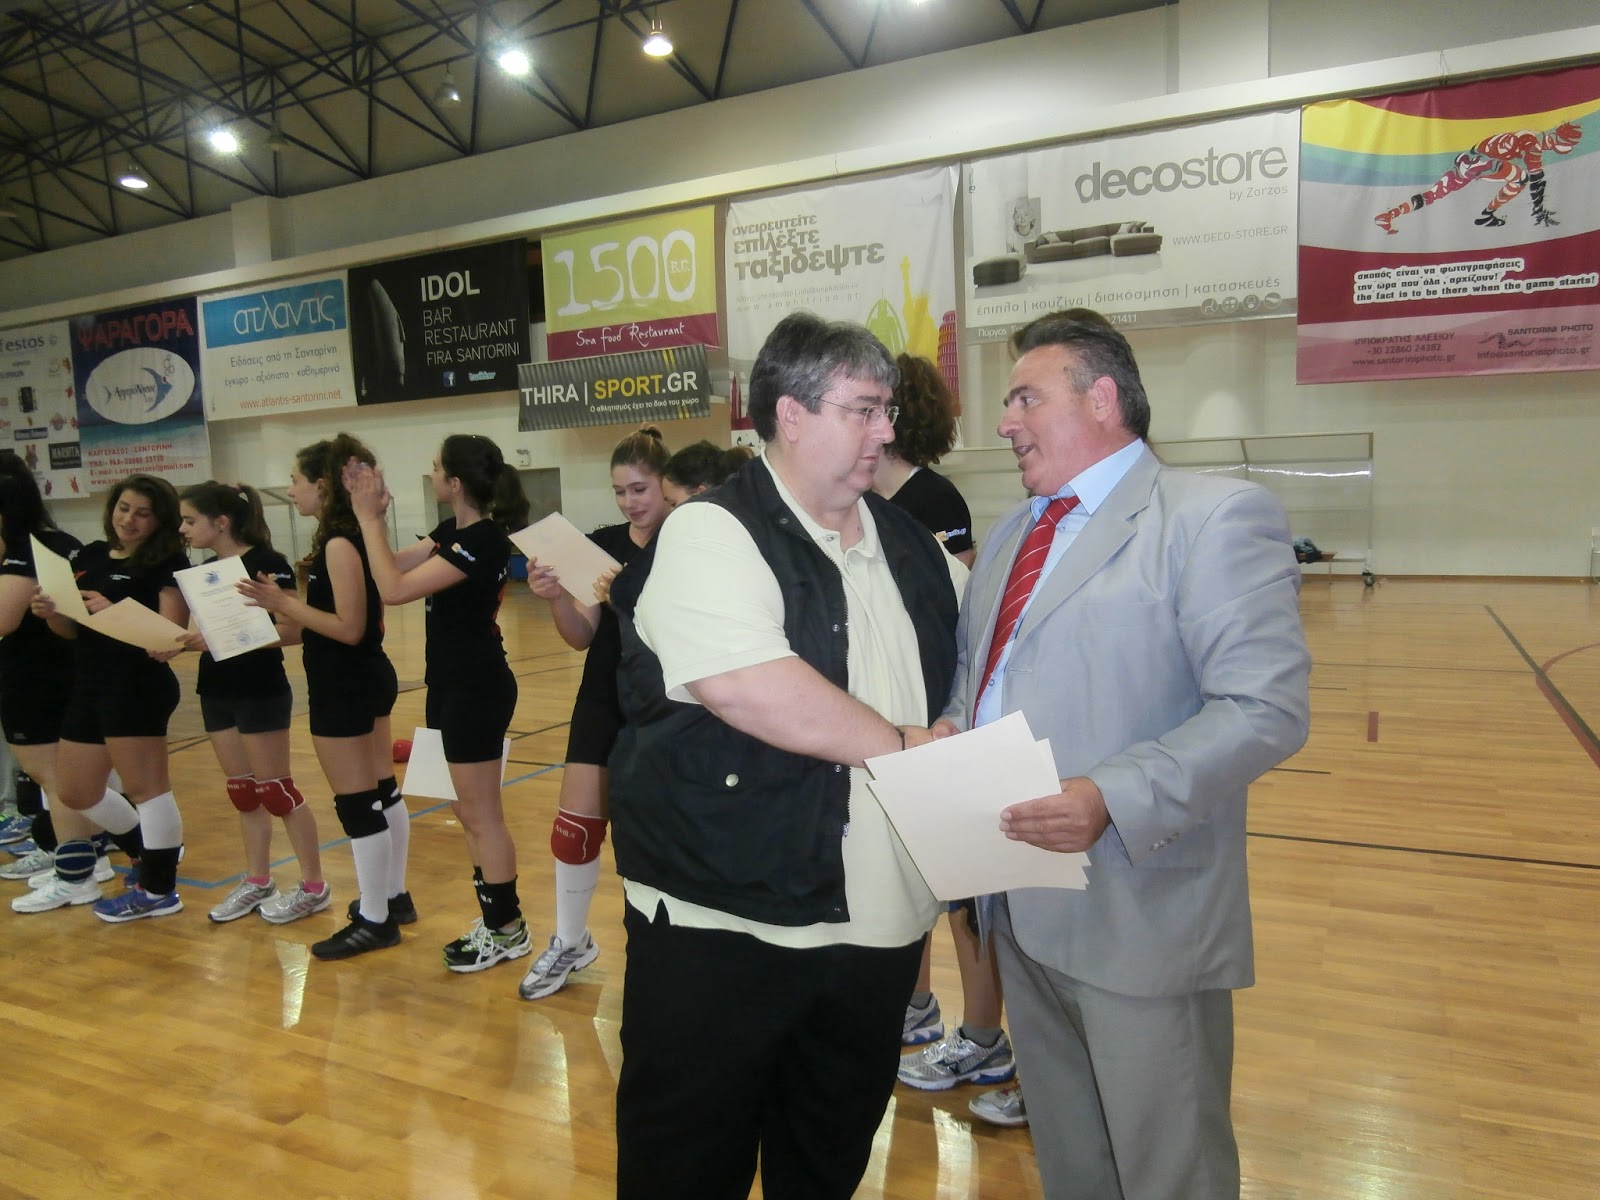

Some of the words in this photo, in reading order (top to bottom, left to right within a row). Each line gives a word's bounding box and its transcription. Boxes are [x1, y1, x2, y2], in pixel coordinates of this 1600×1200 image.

[1074, 146, 1289, 204] decostore
[1229, 188, 1242, 202] by
[1246, 184, 1289, 199] Zorzos
[733, 228, 820, 256] επιλέξτε
[1172, 225, 1289, 247] WWW.DECO-STORE.GR
[553, 228, 697, 317] 1500
[733, 243, 885, 284] ταξιδέψτε
[1357, 270, 1392, 280] σκοπός
[1423, 267, 1436, 275] να
[420, 270, 481, 302] IDOL
[1031, 296, 1084, 311] κουζίνα
[1094, 286, 1180, 304] διακόσμηση
[1193, 276, 1280, 294] κατασκευές
[1356, 293, 1372, 302] the
[1375, 291, 1395, 300] fact
[1398, 290, 1408, 298] is
[1411, 289, 1422, 297] to
[1426, 288, 1438, 296] be
[1441, 285, 1468, 295] there
[1472, 284, 1500, 293] when
[1503, 281, 1521, 291] the
[1525, 280, 1555, 291] game
[1559, 275, 1596, 286] starts!
[78, 308, 195, 349] ΨΑΡΑΓΟΡΑ
[422, 307, 453, 327] BAR
[1507, 325, 1558, 336] SANTORINI
[1560, 323, 1594, 333] PHOTO
[424, 318, 517, 346] RESTAURANT
[575, 330, 598, 347] Sea
[628, 321, 686, 348] Restaurant
[1354, 334, 1413, 346] ΙΠΠΟΚΡΑΤΗΣ
[426, 350, 453, 366] FIRA
[456, 342, 520, 363] SANTORINI
[521, 382, 580, 407] THIRA
[594, 370, 699, 400] SPORT.GR
